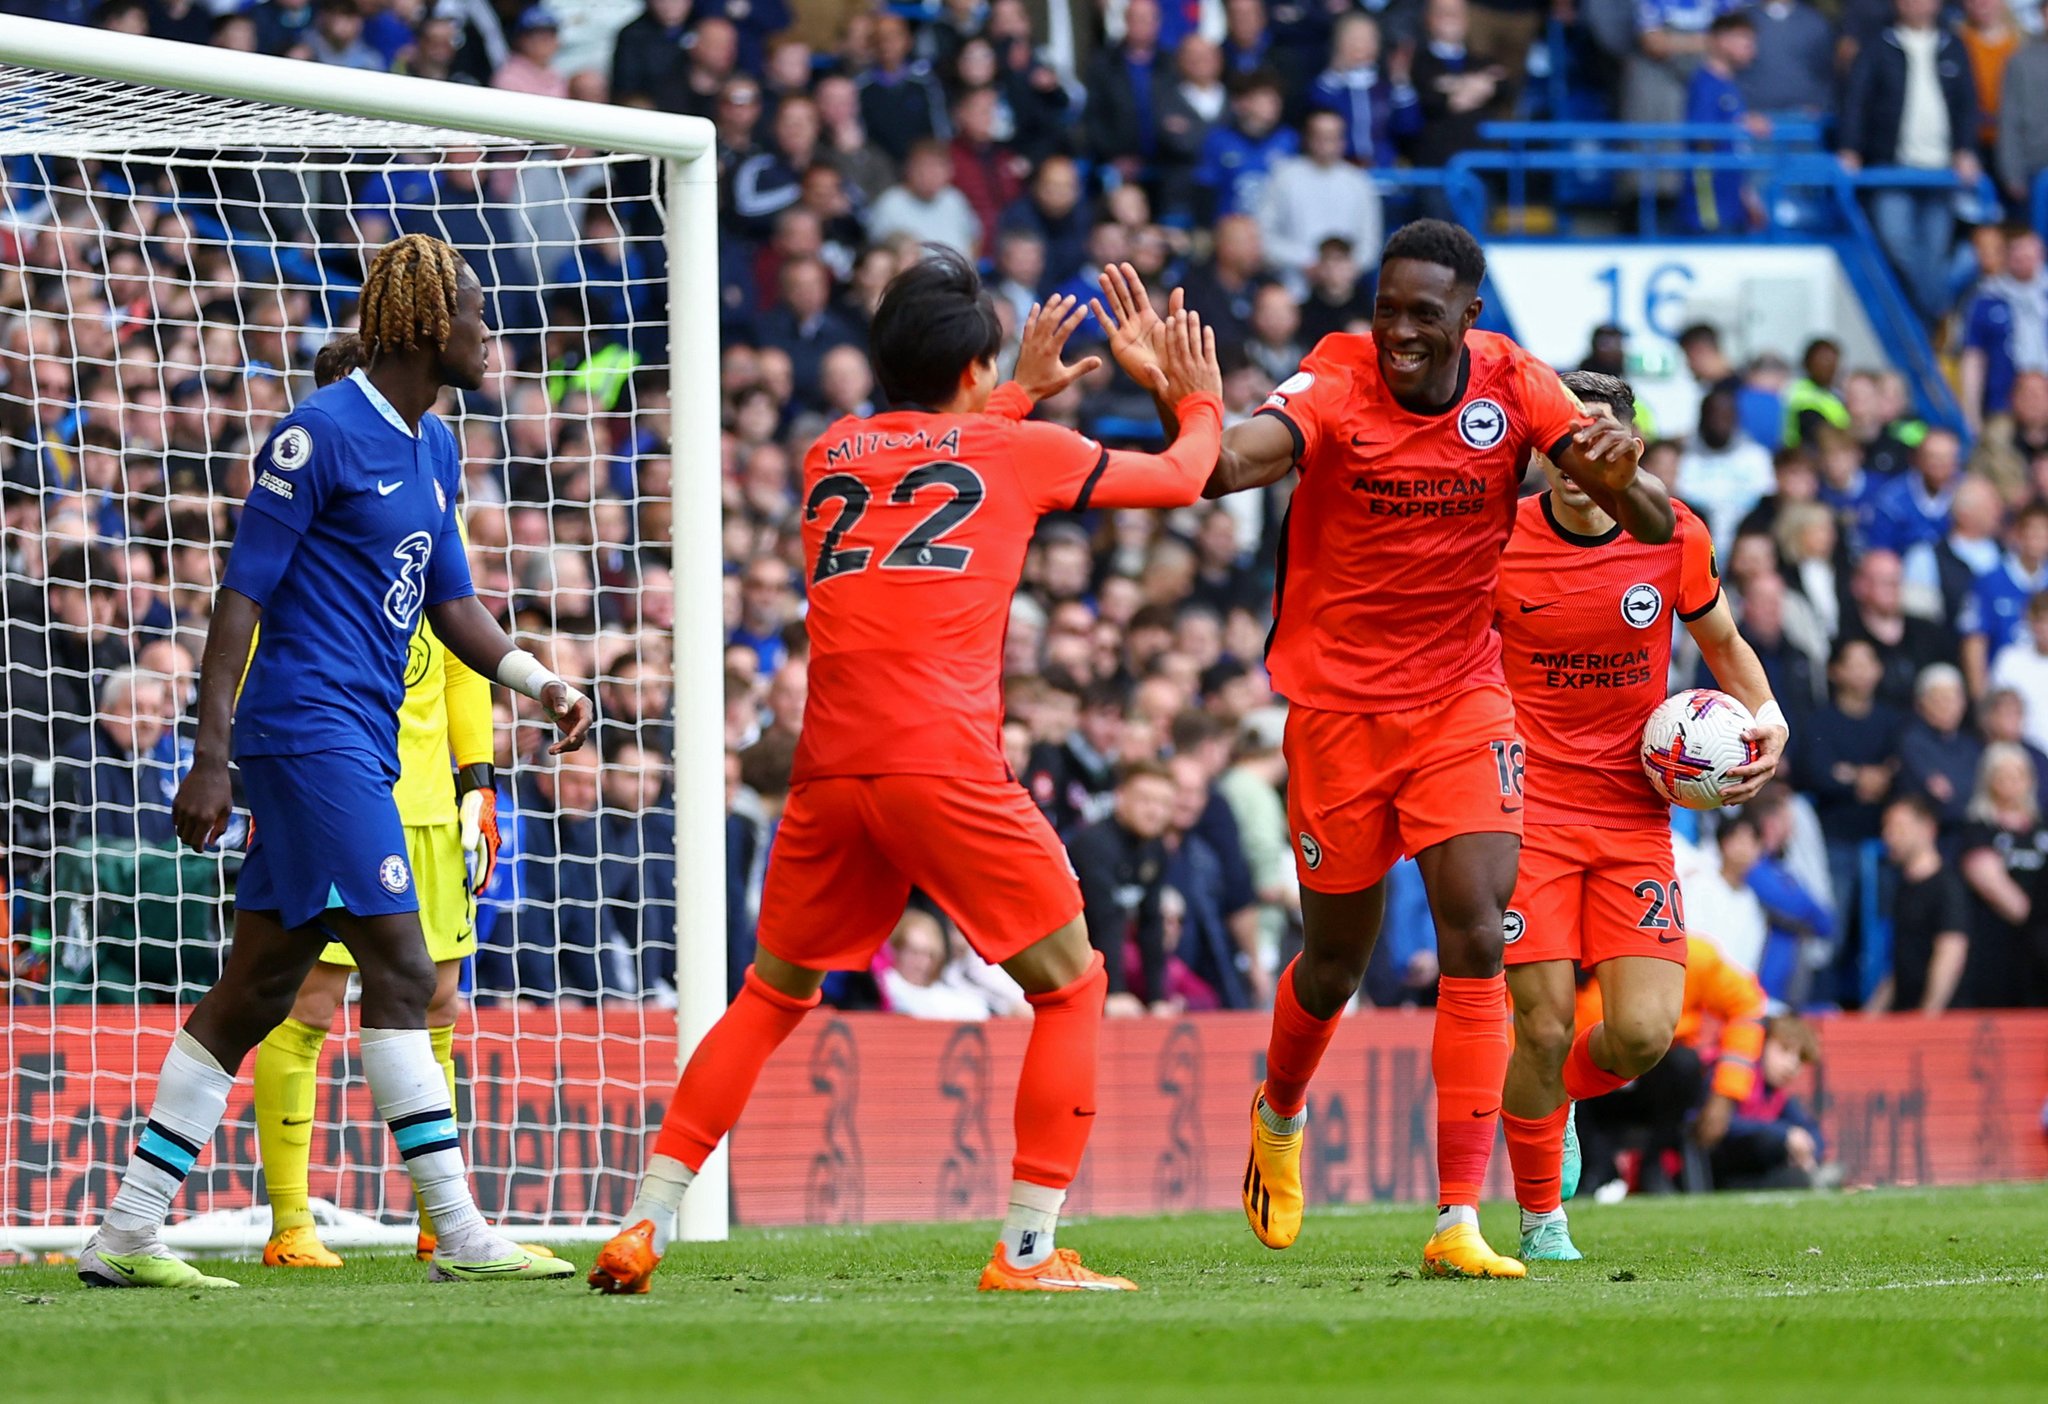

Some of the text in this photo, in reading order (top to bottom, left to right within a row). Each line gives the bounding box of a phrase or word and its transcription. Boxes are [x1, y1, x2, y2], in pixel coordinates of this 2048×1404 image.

[1593, 263, 1695, 343] 16
[1351, 477, 1487, 498] AMERICAN
[803, 459, 987, 589] 22
[1369, 497, 1485, 518] EXPRESS
[1530, 647, 1649, 670] AMERICAN
[1546, 665, 1651, 689] EXPRESS
[1490, 741, 1526, 797] 18
[1633, 879, 1685, 934] 20
